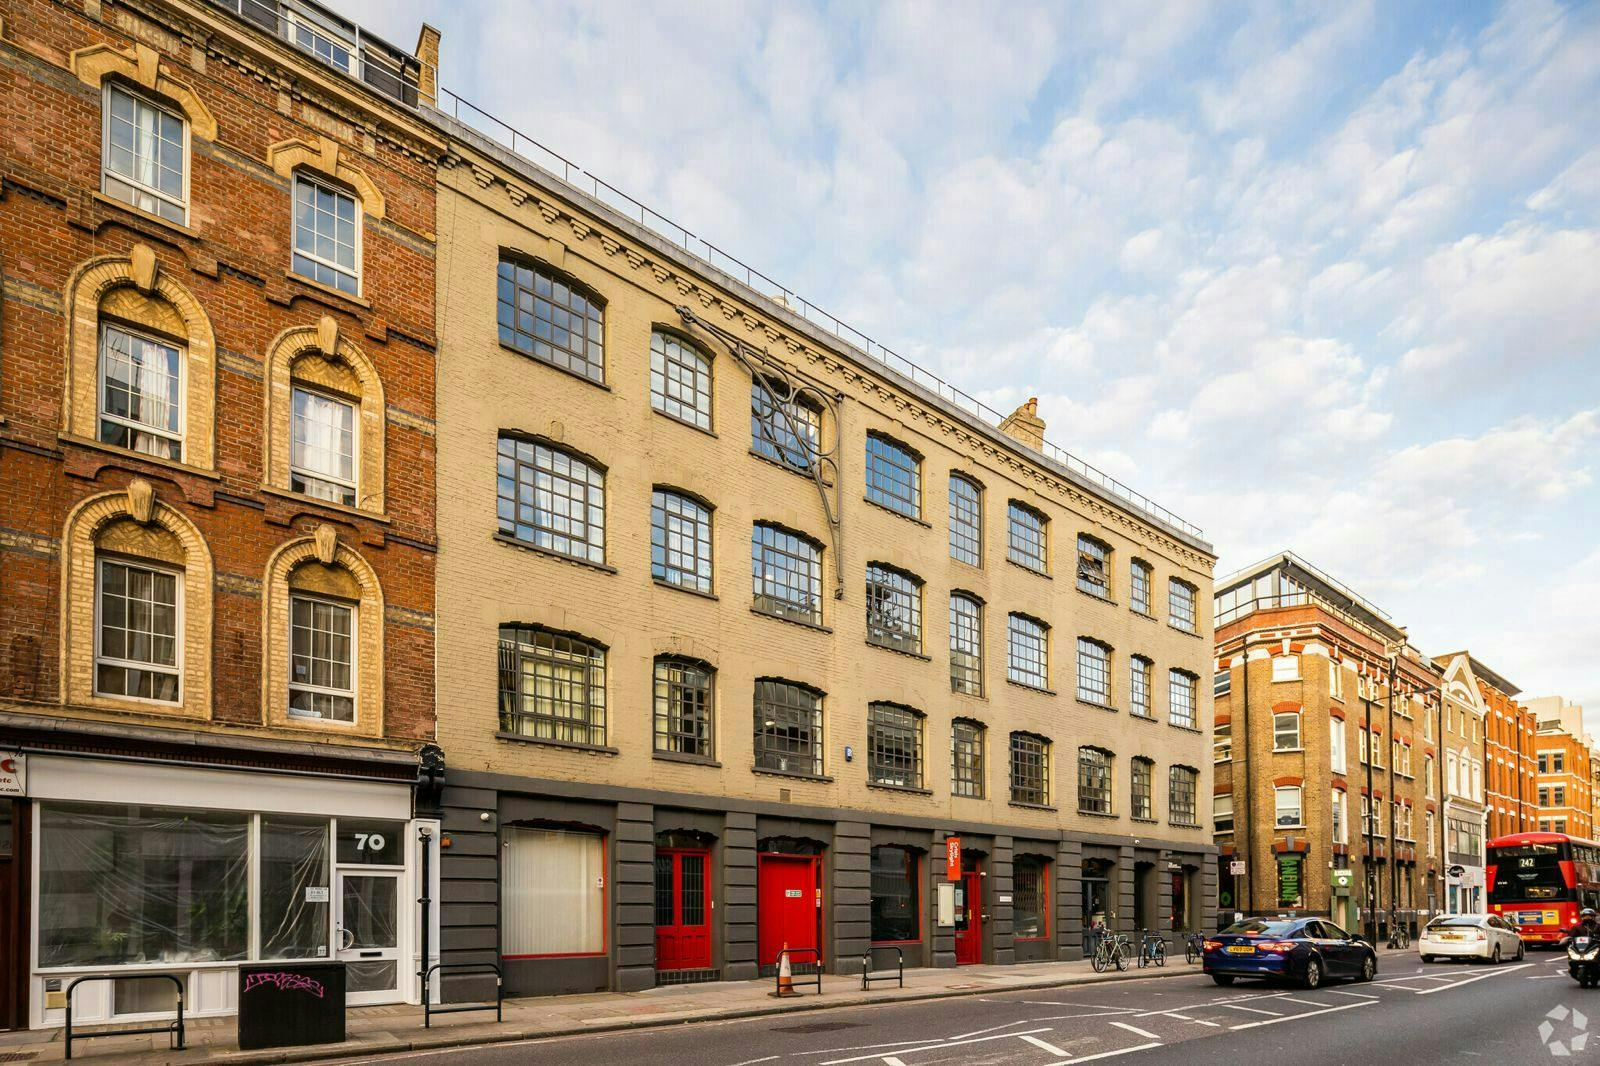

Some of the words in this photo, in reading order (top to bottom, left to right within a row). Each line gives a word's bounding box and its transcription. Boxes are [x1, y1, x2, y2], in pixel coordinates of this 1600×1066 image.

[354, 833, 385, 851] 70
[1520, 858, 1534, 867] 242
[1281, 860, 1298, 902] ANDINA
